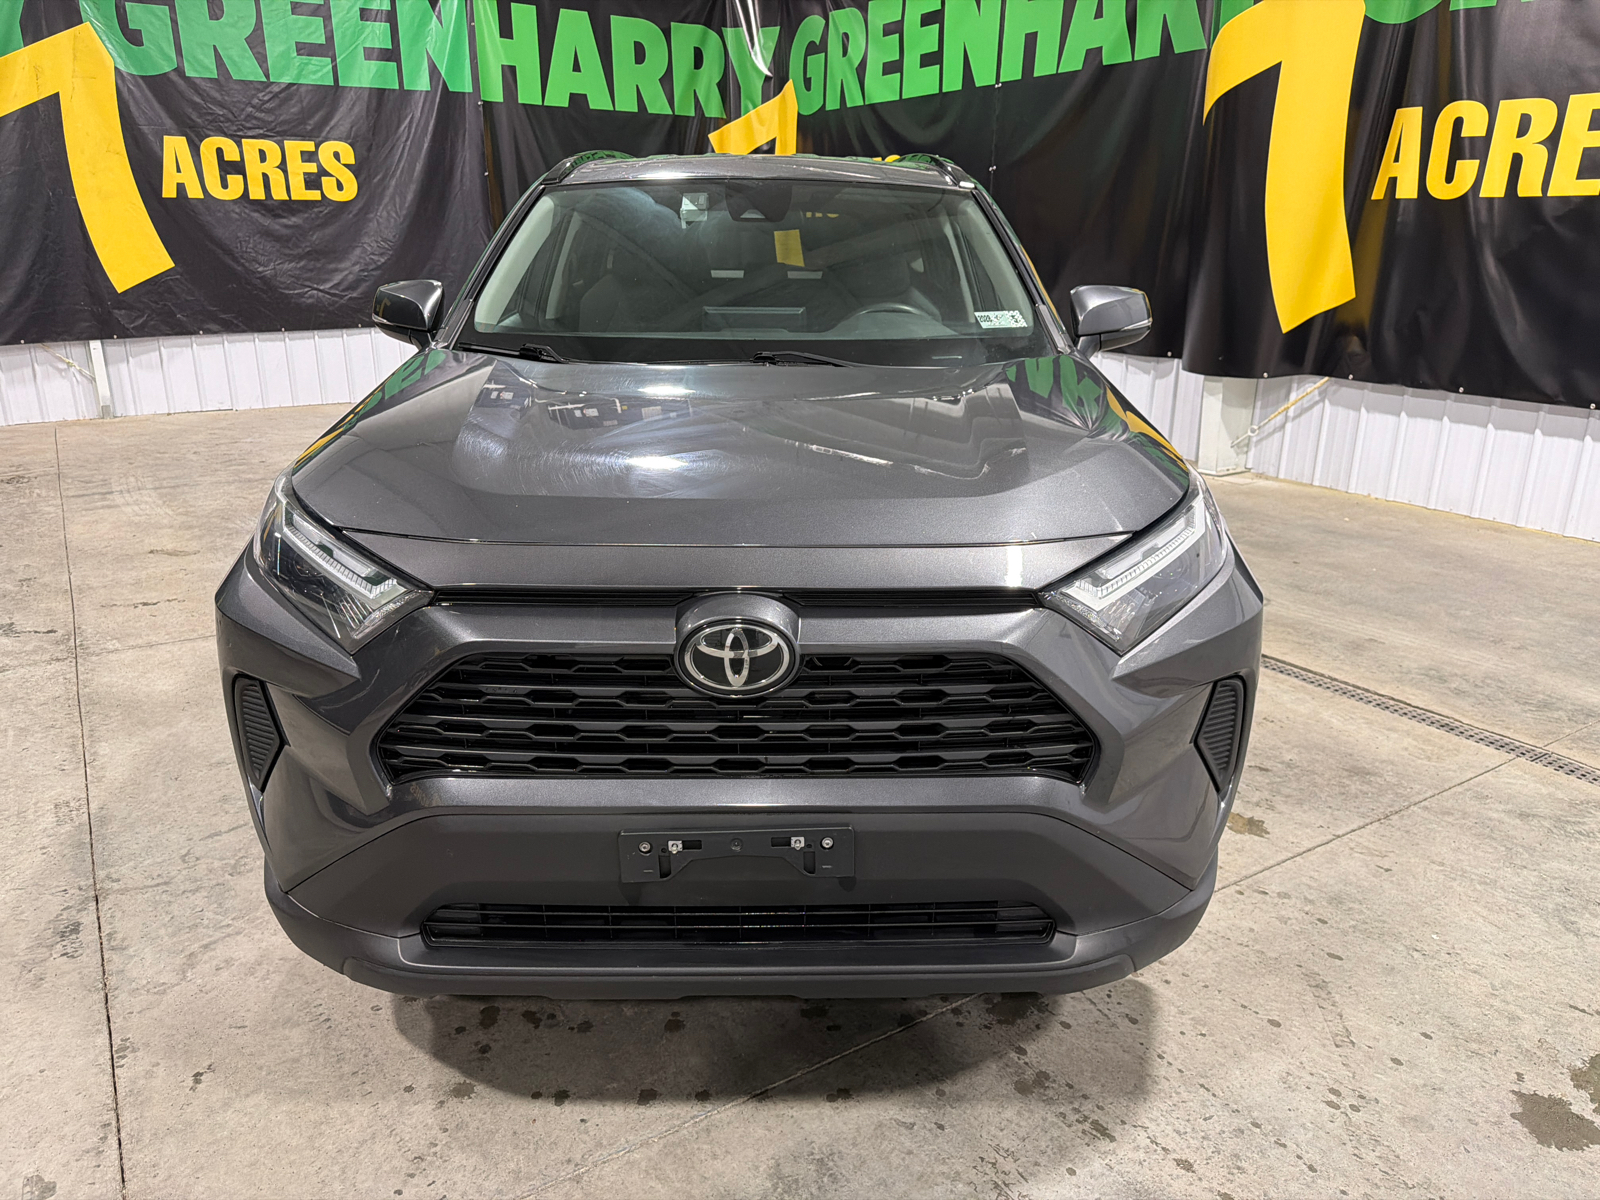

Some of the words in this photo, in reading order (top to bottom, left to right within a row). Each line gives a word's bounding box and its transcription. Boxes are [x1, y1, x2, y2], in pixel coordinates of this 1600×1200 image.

[80, 0, 473, 93] GREEN
[473, 0, 780, 119] HARRY
[789, 0, 1000, 115] GREEN
[162, 135, 358, 202] ACRES
[1202, 0, 1356, 334] 7
